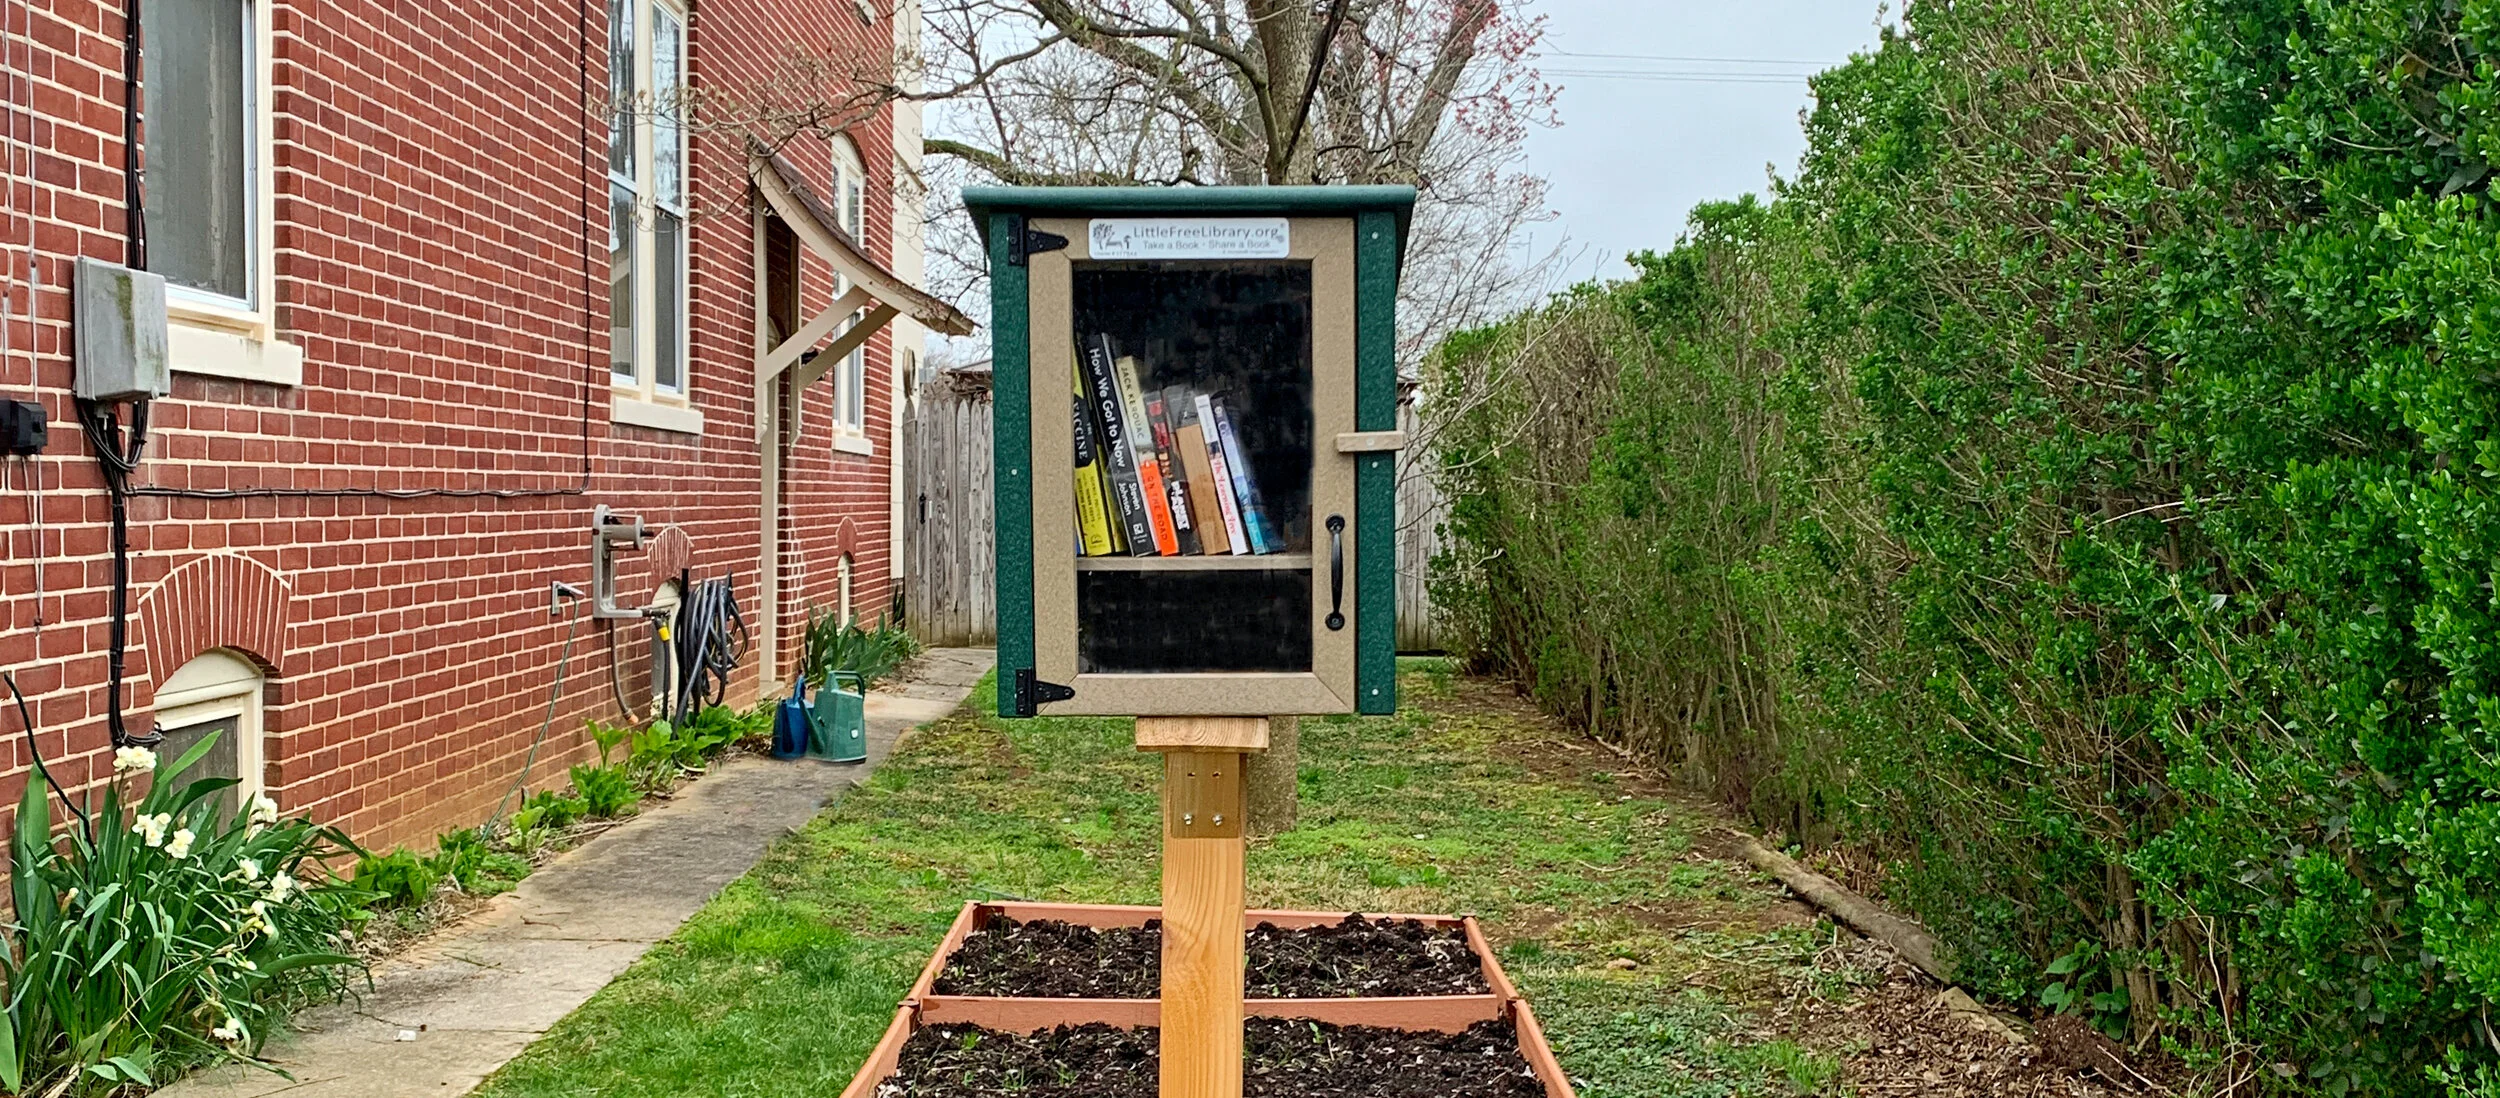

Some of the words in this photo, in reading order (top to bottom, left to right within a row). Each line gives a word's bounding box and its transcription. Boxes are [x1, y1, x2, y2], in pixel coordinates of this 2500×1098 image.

[1133, 225, 1279, 239] LittleFreeLibrary.org
[1143, 240, 1164, 249] Take
[1175, 240, 1199, 249] Book
[1208, 239, 1235, 249] Share
[1239, 240, 1245, 248] a
[1247, 240, 1270, 248] Book
[1089, 348, 1102, 376] How
[1098, 376, 1109, 398] We
[1102, 400, 1116, 422] Got
[1121, 366, 1131, 390] JACK
[1128, 393, 1144, 438] KEROUAC
[1073, 402, 1088, 459] VACCINE
[1108, 424, 1118, 437] to
[1112, 439, 1125, 467] Now
[1118, 483, 1132, 516] Johnson
[1129, 483, 1140, 510] Steven
[1147, 475, 1155, 489] ON
[1152, 492, 1160, 509] THE
[1157, 513, 1168, 540] ROAD
